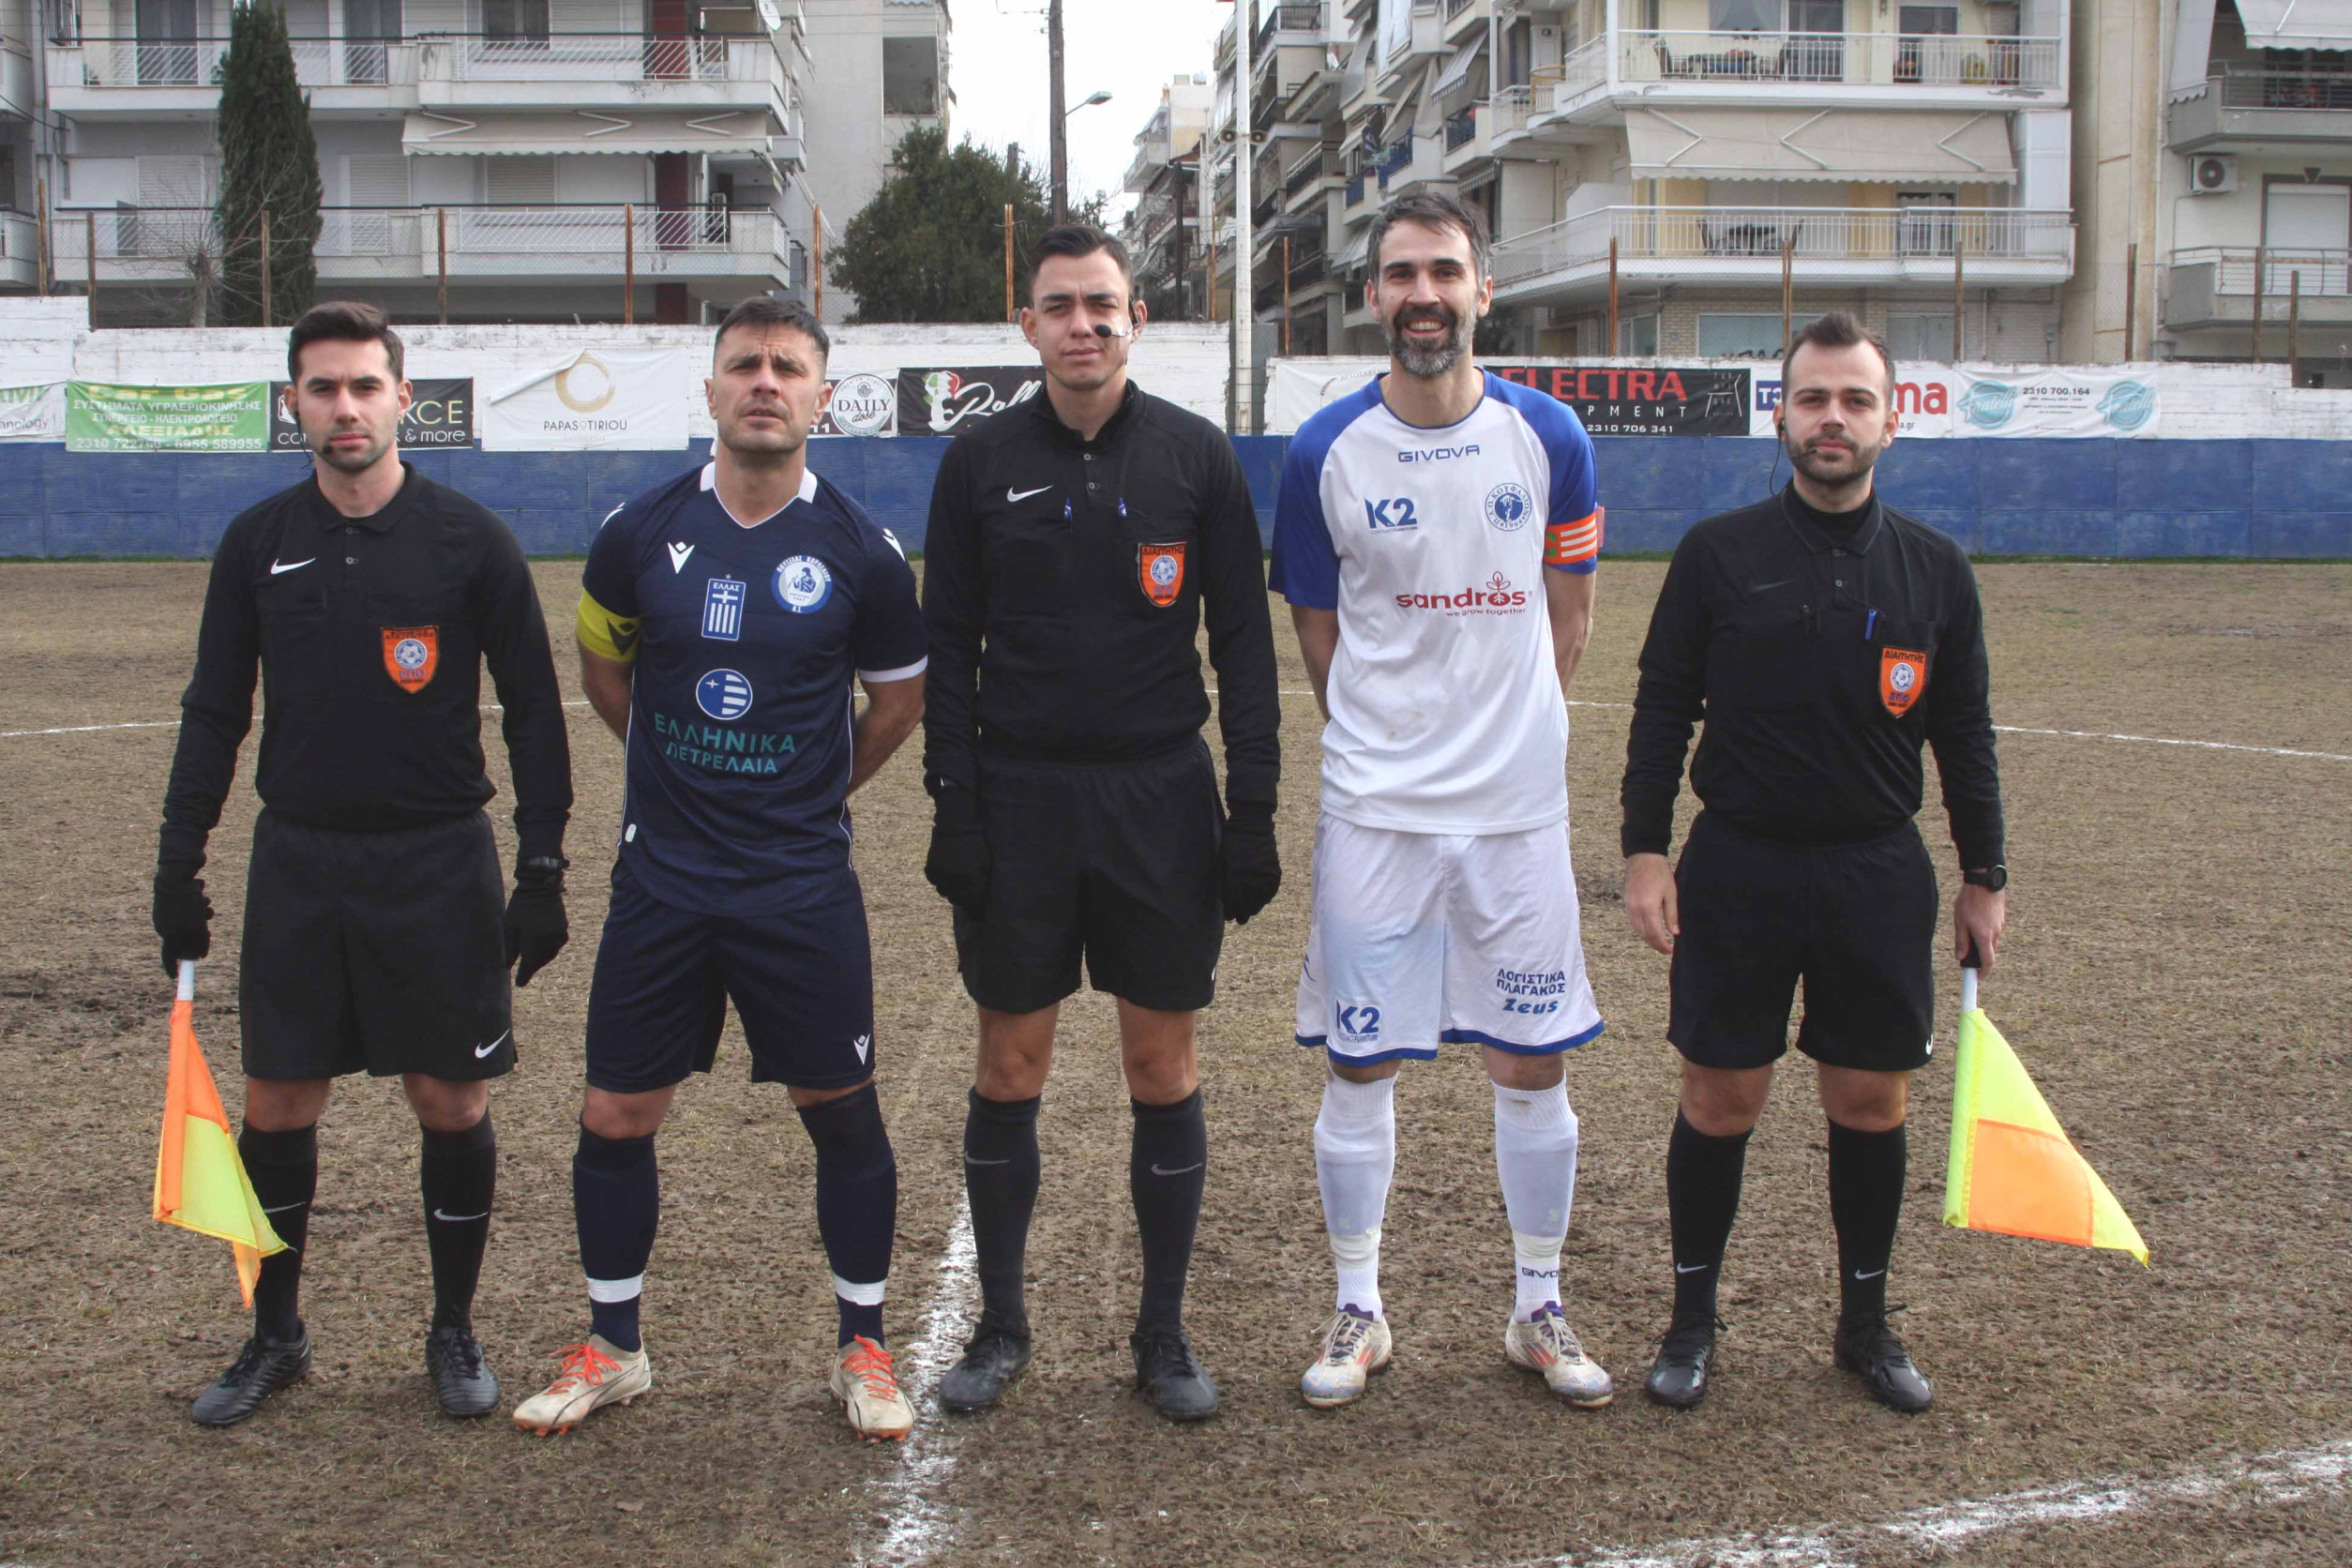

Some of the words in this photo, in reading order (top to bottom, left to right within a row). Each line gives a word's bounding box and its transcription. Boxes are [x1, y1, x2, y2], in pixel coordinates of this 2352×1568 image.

[2023, 387, 2047, 396] 2310
[1894, 382, 1947, 415] ma
[838, 399, 891, 412] DAILY
[1587, 405, 1687, 417] PMENT
[544, 420, 627, 430] PAPASOTIRIOU
[809, 423, 831, 433] 11
[1587, 424, 1619, 432] 2310
[1623, 425, 1647, 433] 706
[1651, 425, 1673, 433] 341
[1898, 422, 1915, 431] a.gr
[76, 437, 109, 449] 2310
[174, 438, 208, 449] 6955
[421, 430, 466, 443] more
[1397, 445, 1481, 462] GIVOVA
[1364, 498, 1418, 529] K2
[713, 582, 741, 592] ΕΛΛΑΣ
[1395, 588, 1527, 610] sandros
[1486, 608, 1526, 616] together
[655, 712, 796, 754] ΕΛΛΗΝΙΚΑ
[667, 741, 778, 774] ΠΕΤΡΕΛΑΙΑ
[1498, 968, 1565, 985] ΛΟΓΙΣΤΙΚΑ
[1497, 978, 1565, 996] ΠΛΑΓΑΚΟΣ
[1502, 998, 1559, 1015] Zeus
[1336, 999, 1380, 1034] K2
[1522, 1267, 1560, 1278] GIVO
